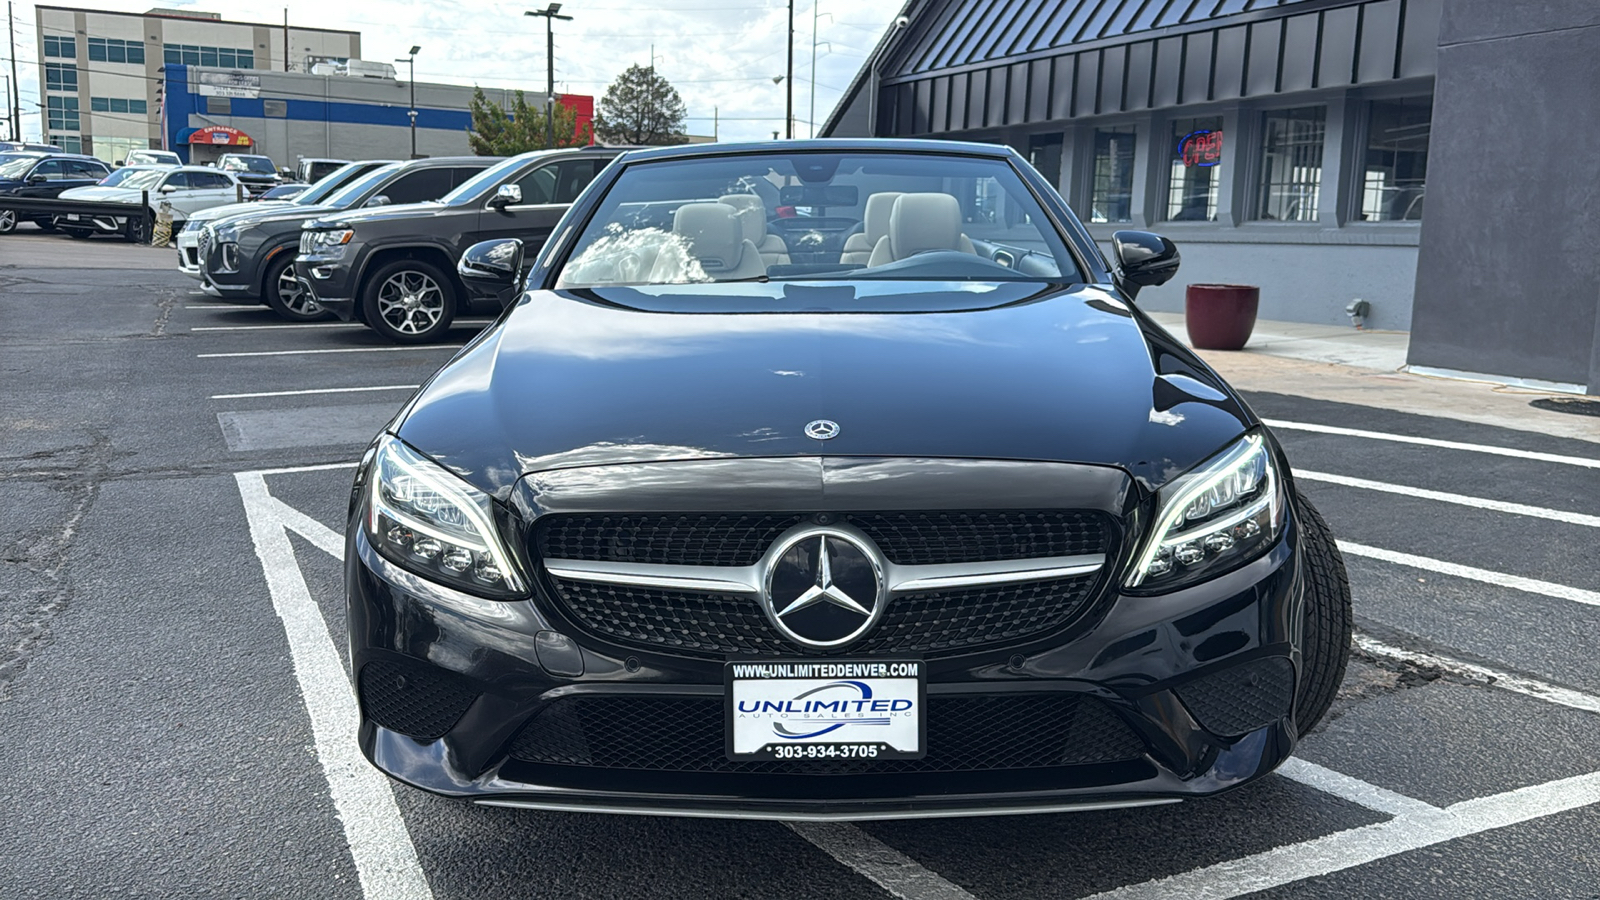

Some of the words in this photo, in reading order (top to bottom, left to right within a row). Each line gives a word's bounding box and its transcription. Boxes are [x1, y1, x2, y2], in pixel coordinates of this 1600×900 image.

[204, 126, 238, 135] ENTRANCE
[732, 663, 918, 678] WWWUNLIMITEDDENVER.COM
[738, 699, 913, 713] UNLIMITED
[774, 745, 878, 759] 303-934-3705
